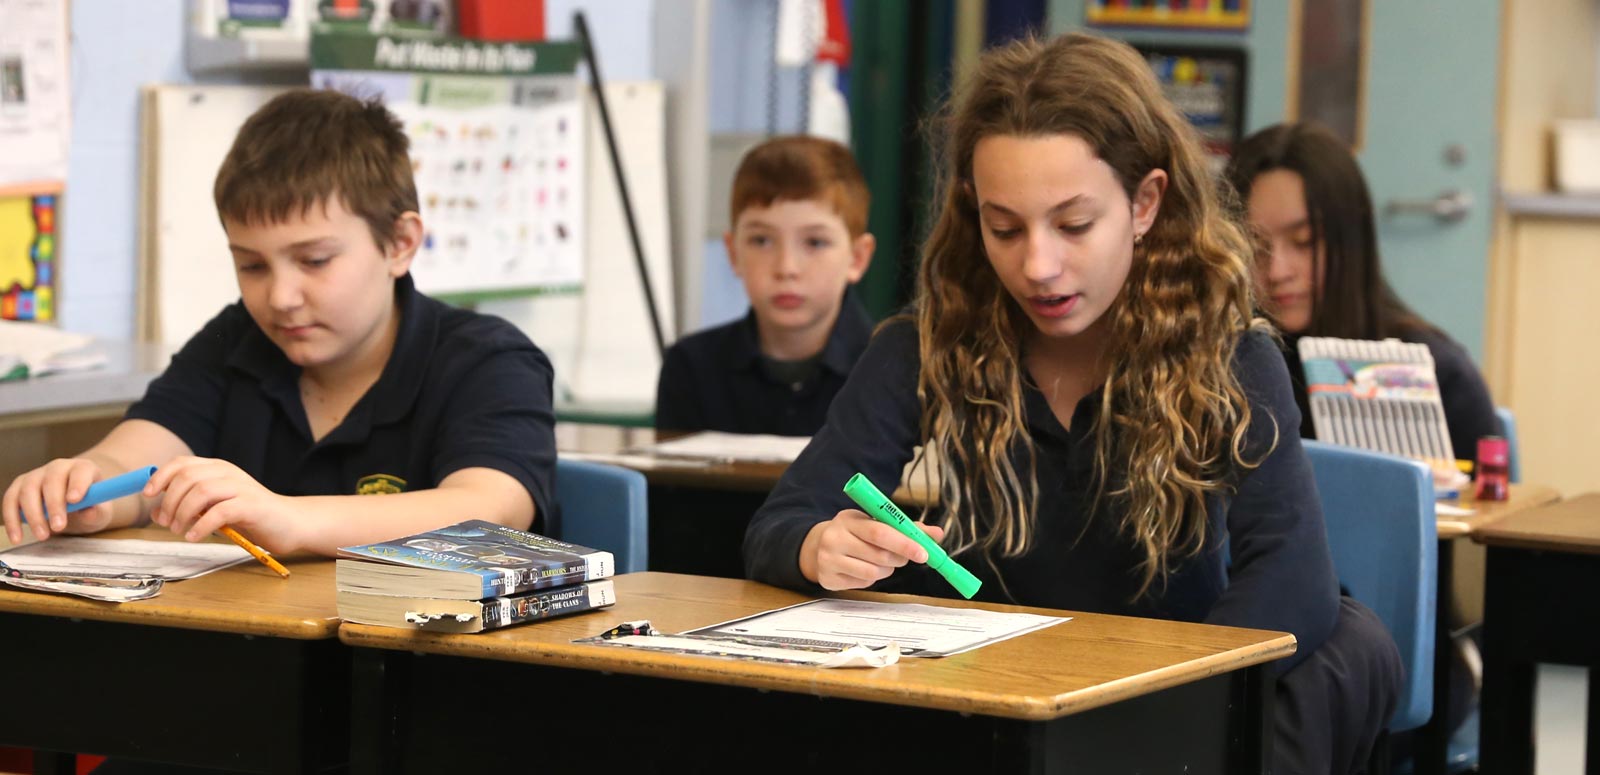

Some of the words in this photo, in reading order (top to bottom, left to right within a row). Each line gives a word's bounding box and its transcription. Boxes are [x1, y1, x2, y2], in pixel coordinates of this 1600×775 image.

[551, 590, 576, 601] SHADOWS
[552, 601, 562, 610] THE
[562, 599, 579, 608] CLANS
